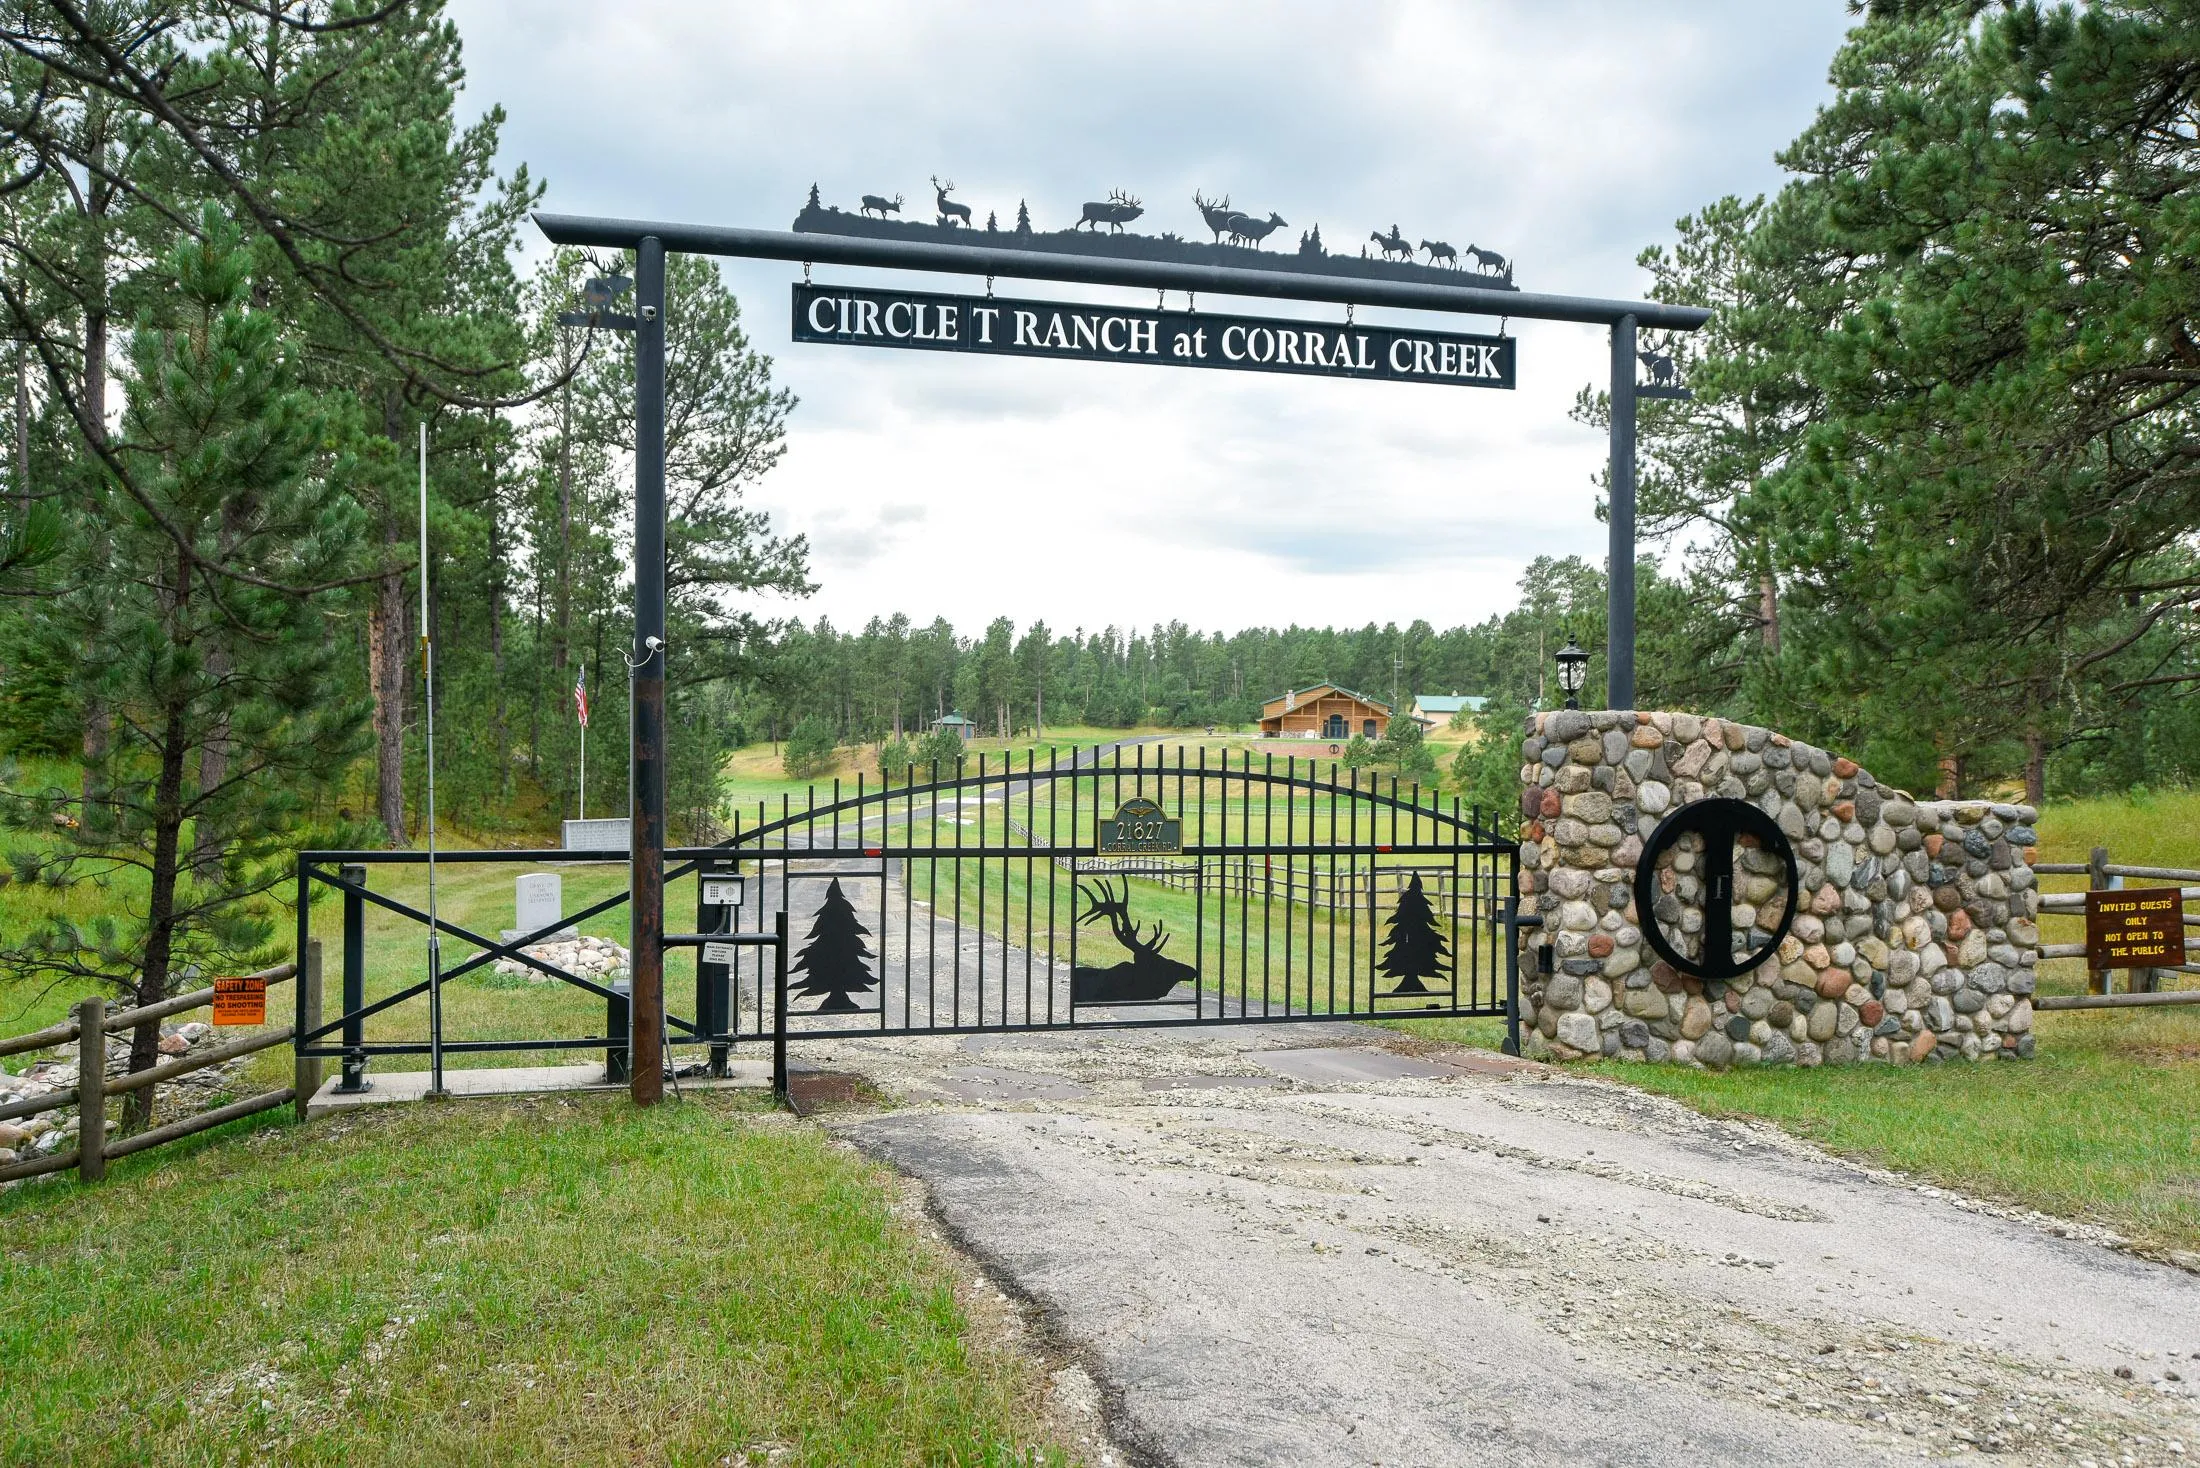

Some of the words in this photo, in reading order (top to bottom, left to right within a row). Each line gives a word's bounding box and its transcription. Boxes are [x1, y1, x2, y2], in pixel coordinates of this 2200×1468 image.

[808, 296, 960, 342] CIRCLE
[973, 307, 1000, 344] T
[1013, 310, 1159, 355] RANCH
[1173, 327, 1208, 359] at
[1221, 325, 1376, 370] CORRAL
[1389, 338, 1502, 379] CREEK
[1117, 821, 1163, 840] 21827
[1107, 842, 1136, 852] CORRAL
[1138, 841, 1160, 852] CREEK
[2099, 902, 2136, 912] INVITED
[2140, 900, 2172, 910] GUESTS
[2125, 917, 2147, 926] ONLY
[2105, 933, 2121, 942] NOT
[2126, 932, 2148, 941] OPEN
[2152, 931, 2164, 940] TO
[2111, 947, 2128, 957] THE
[2132, 946, 2165, 955] PUBLIC
[216, 980, 242, 992] SAFETY
[245, 979, 264, 990] ZONE
[227, 1001, 263, 1009] SHOOTING
